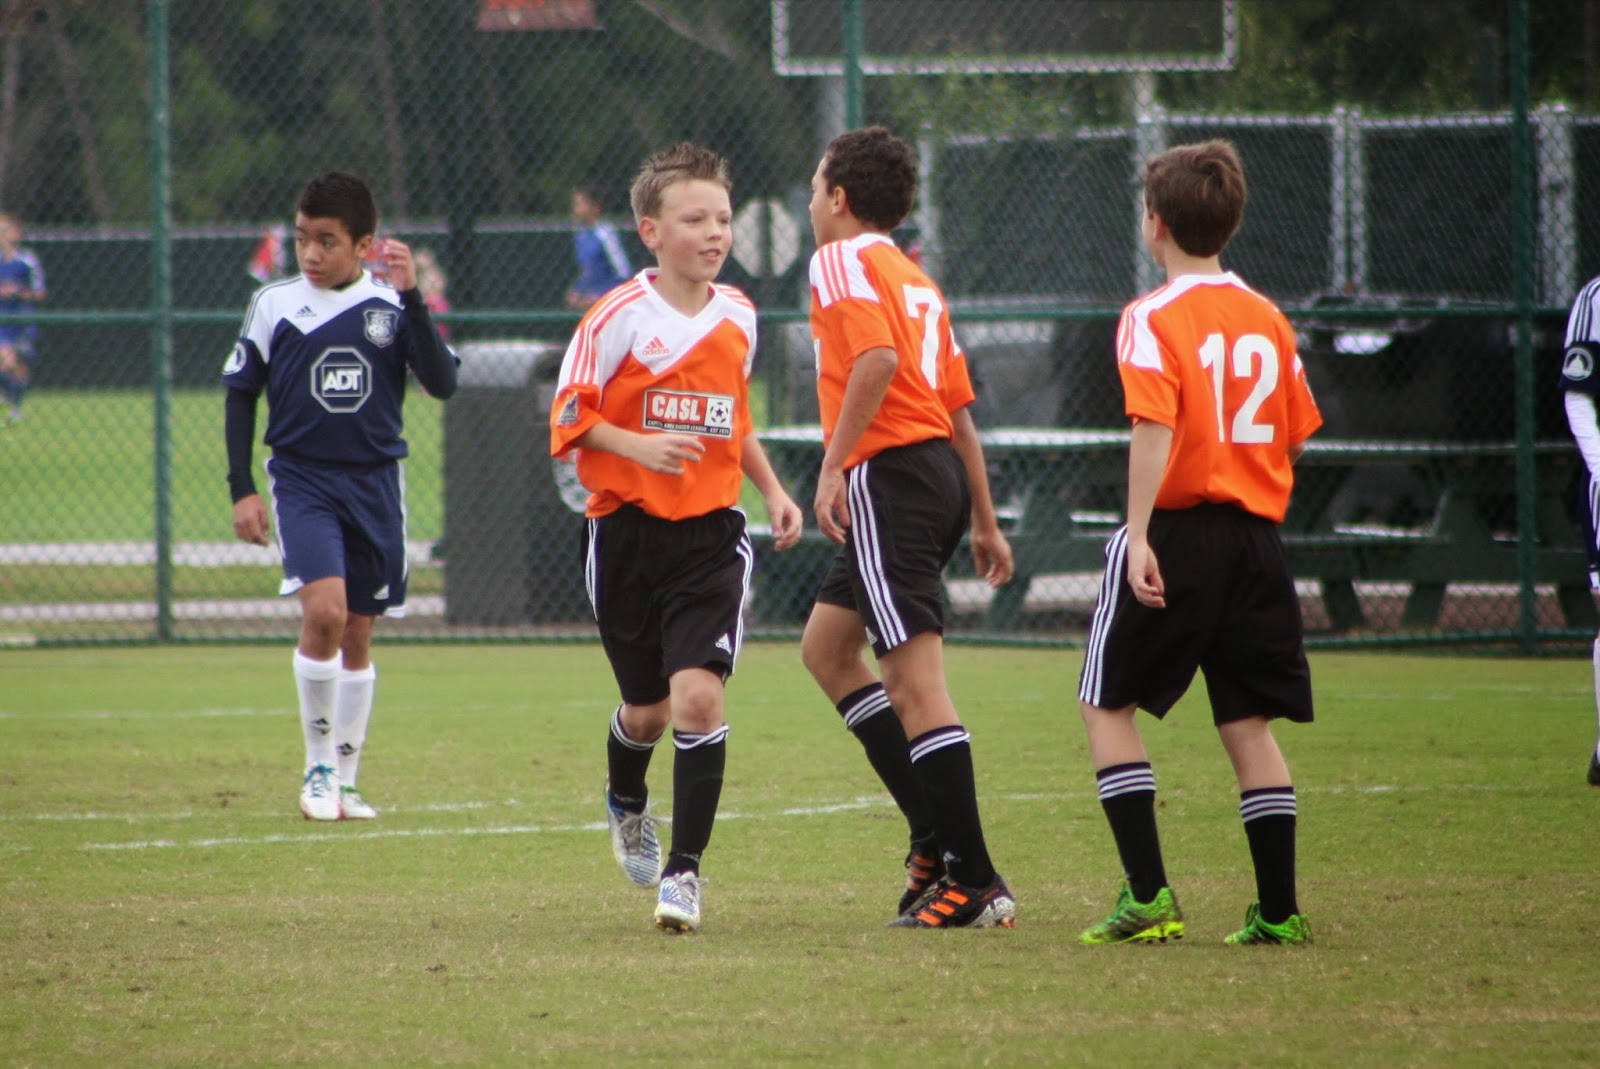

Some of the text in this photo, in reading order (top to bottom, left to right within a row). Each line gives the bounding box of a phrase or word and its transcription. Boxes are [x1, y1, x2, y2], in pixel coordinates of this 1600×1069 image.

[903, 284, 942, 389] 7
[323, 370, 362, 391] ADT
[652, 395, 701, 421] CASL
[1199, 333, 1279, 443] 12
